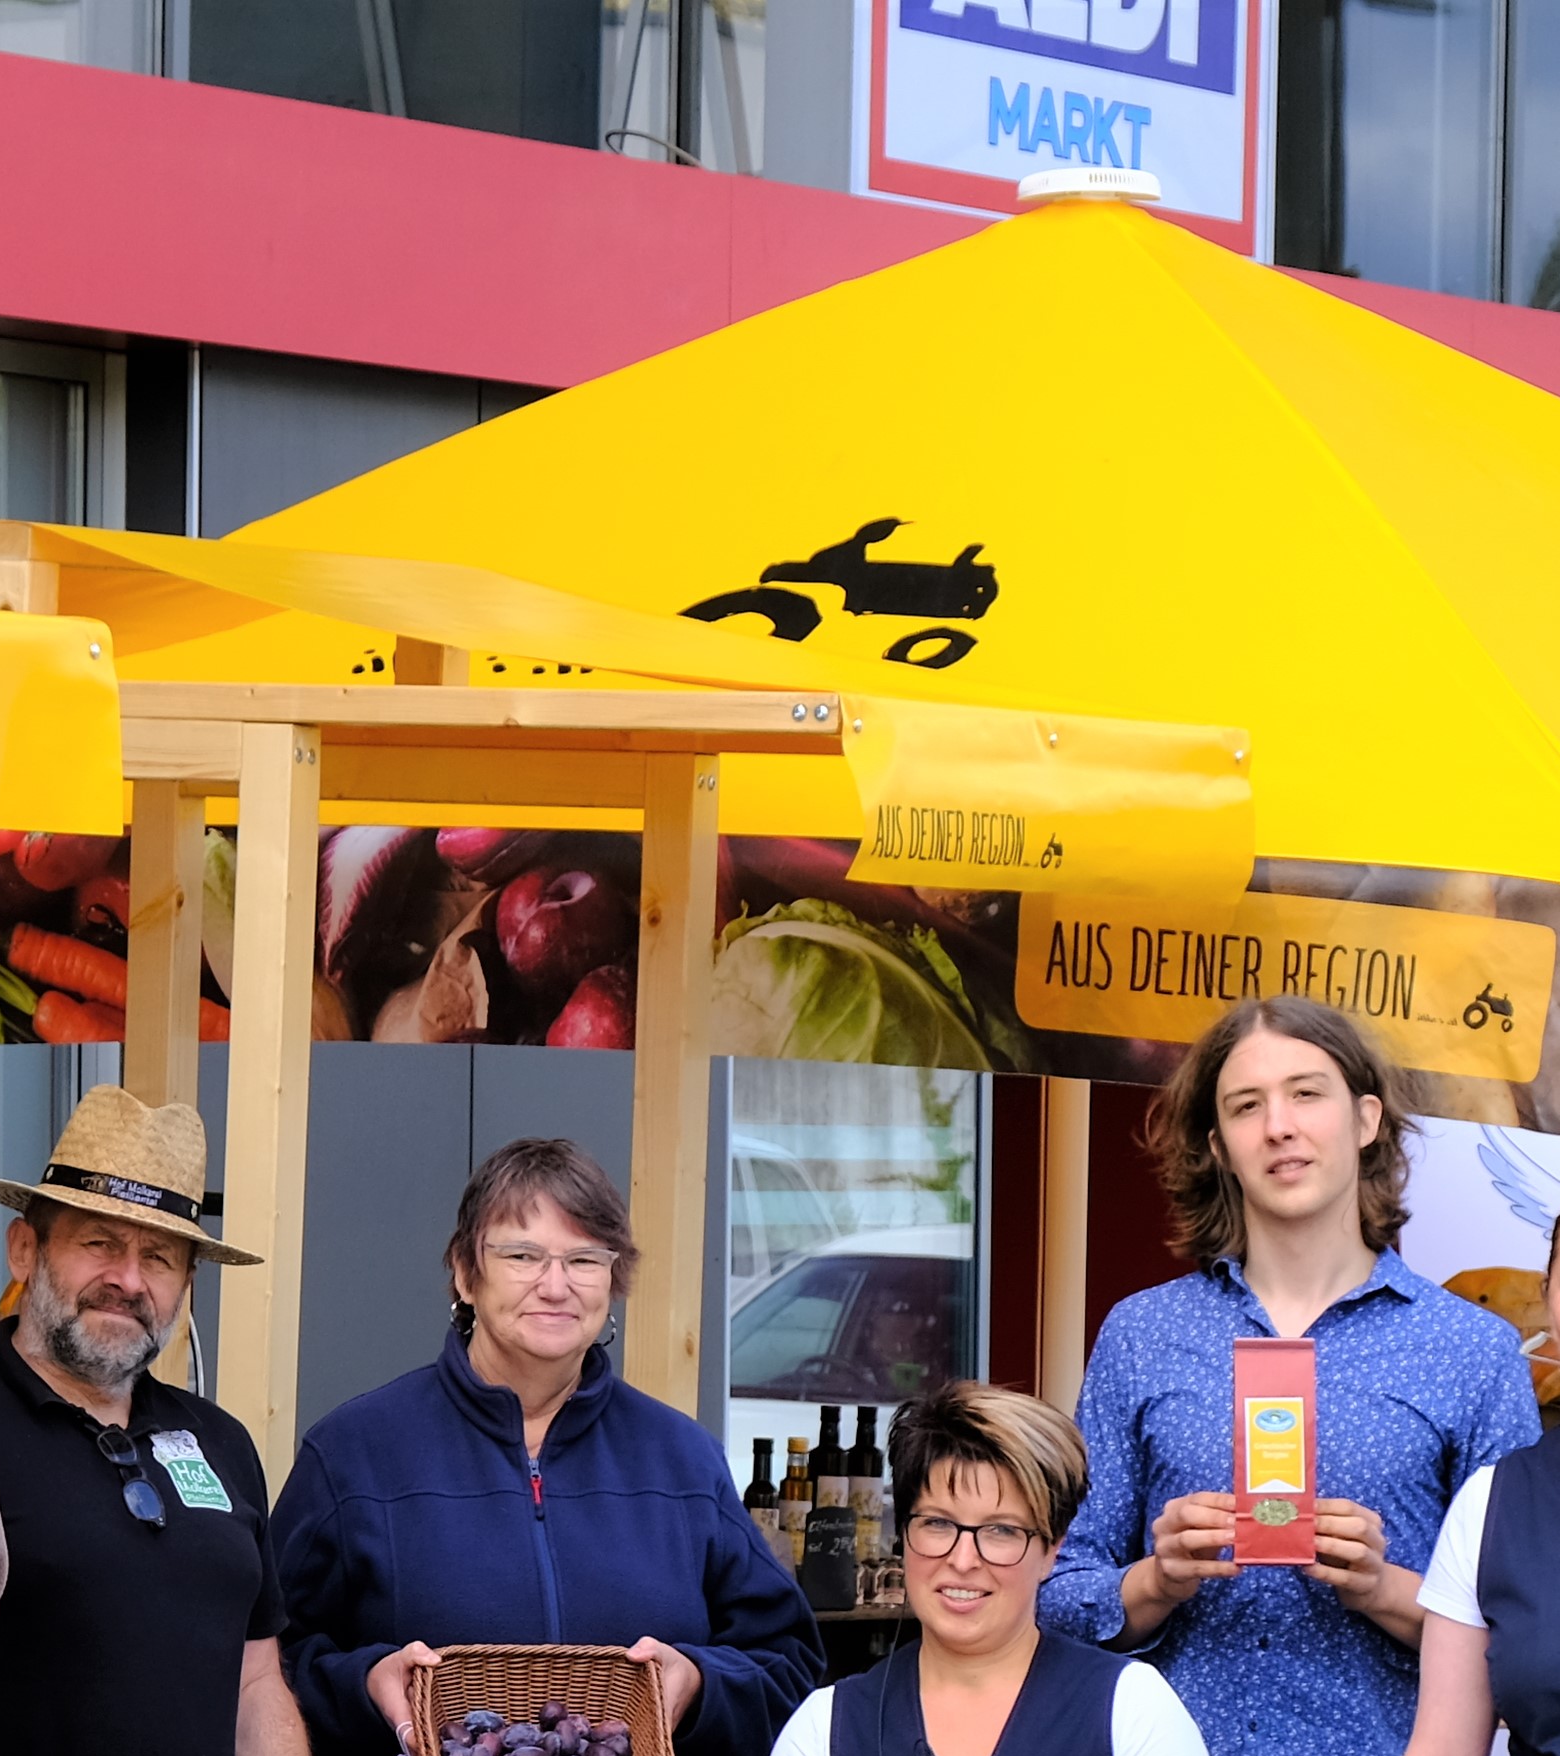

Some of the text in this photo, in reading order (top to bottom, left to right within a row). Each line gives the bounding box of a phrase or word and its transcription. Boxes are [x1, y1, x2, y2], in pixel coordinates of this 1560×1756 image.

[988, 76, 1152, 170] MARKT
[870, 804, 904, 859] AUS
[907, 807, 965, 863] DEINER
[1045, 920, 1113, 990] AUS
[1129, 925, 1264, 1000] DEINER
[172, 1461, 209, 1484] Hof
